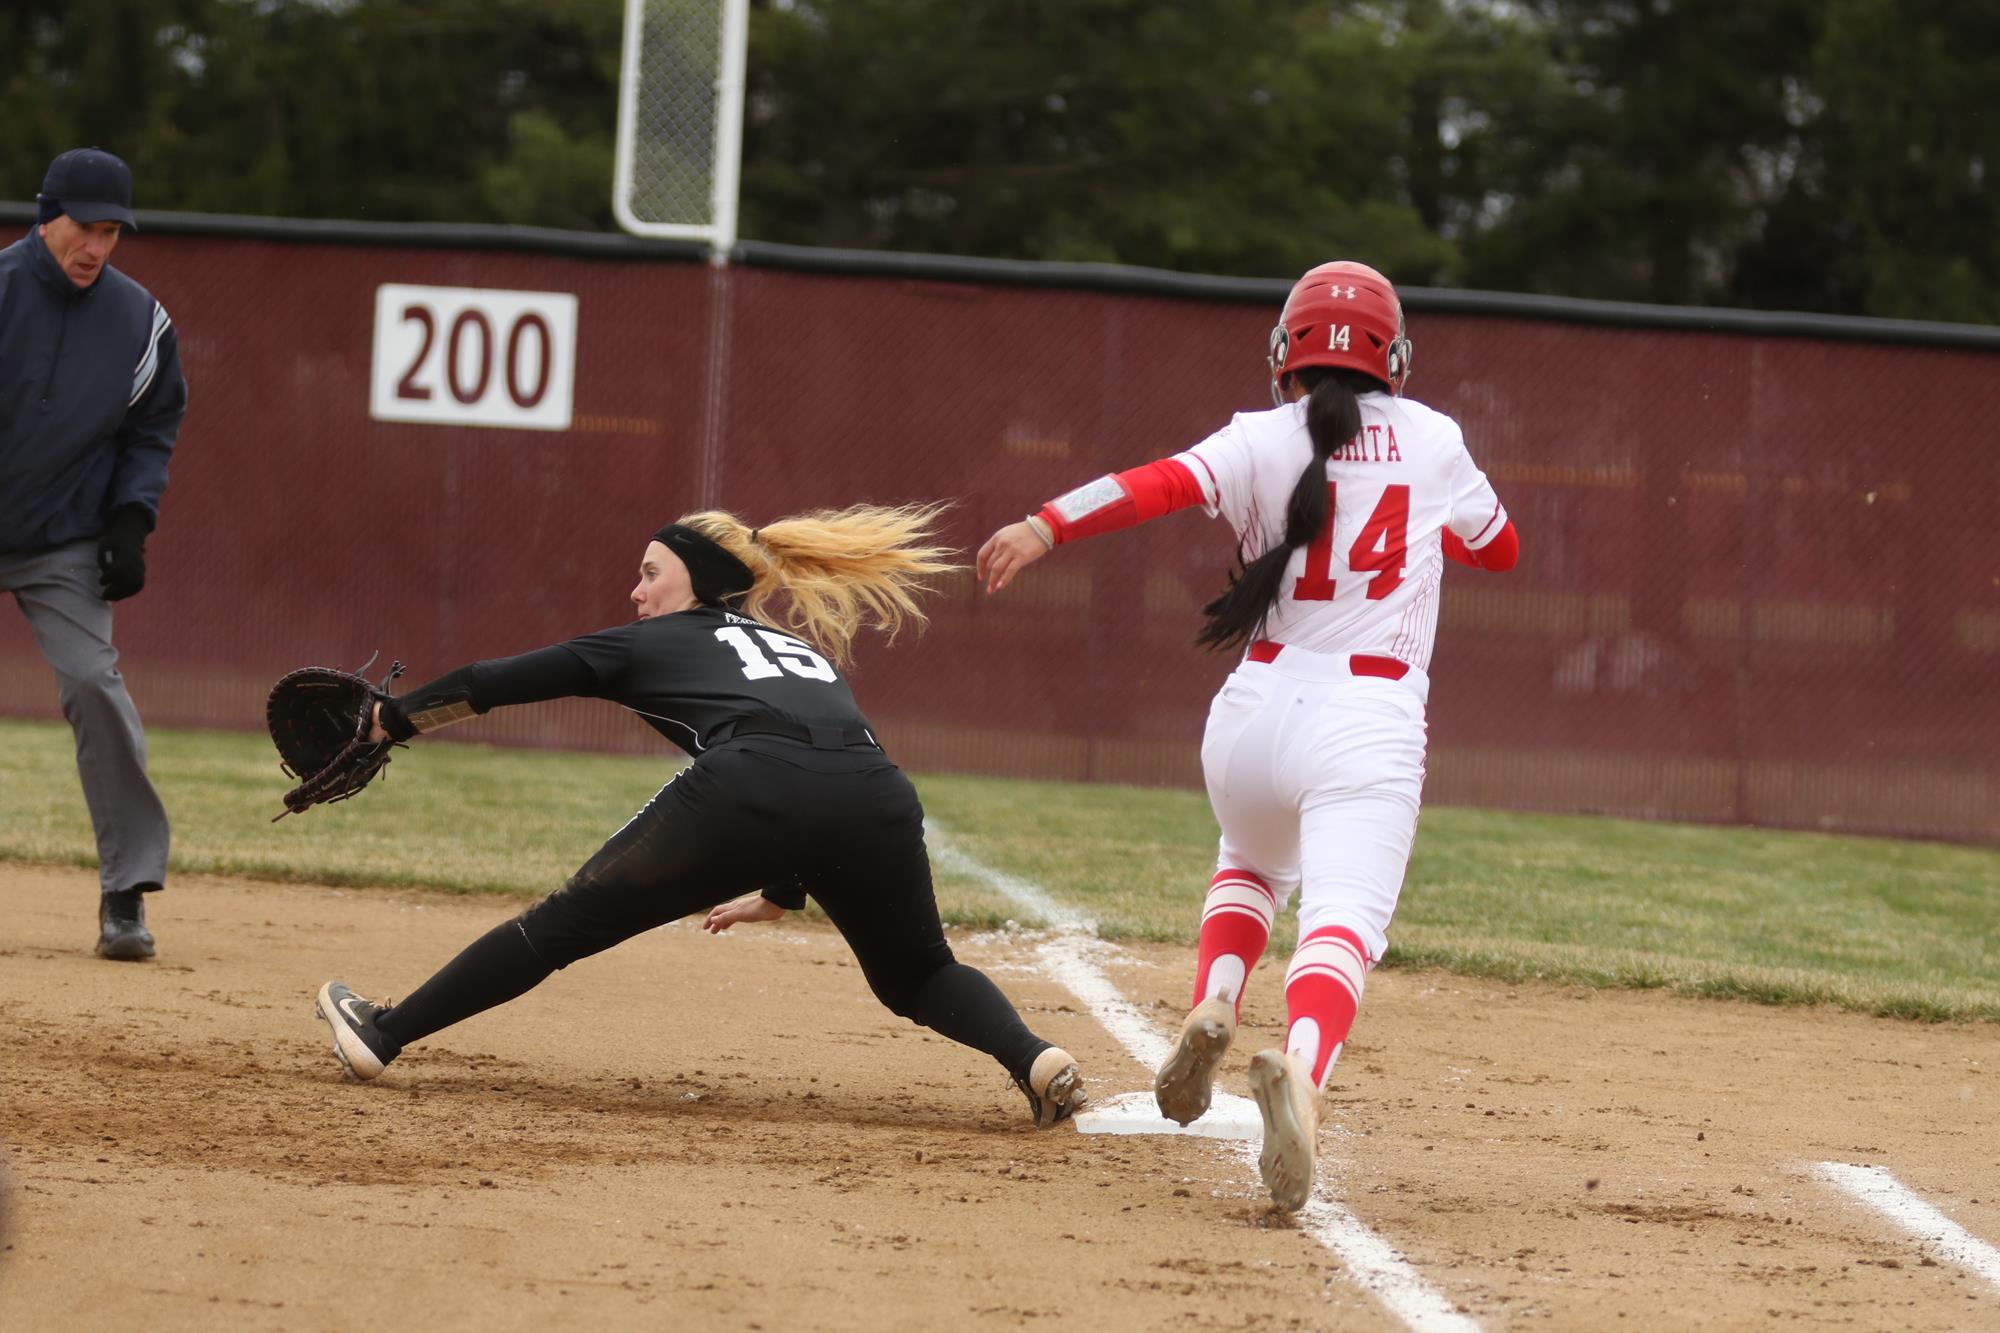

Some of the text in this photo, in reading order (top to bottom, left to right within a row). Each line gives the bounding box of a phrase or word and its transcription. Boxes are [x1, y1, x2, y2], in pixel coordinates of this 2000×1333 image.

[396, 305, 551, 409] 200
[1328, 324, 1350, 351] 14
[1331, 424, 1402, 462] HITA
[1293, 480, 1410, 601] 14
[713, 626, 838, 683] 15
